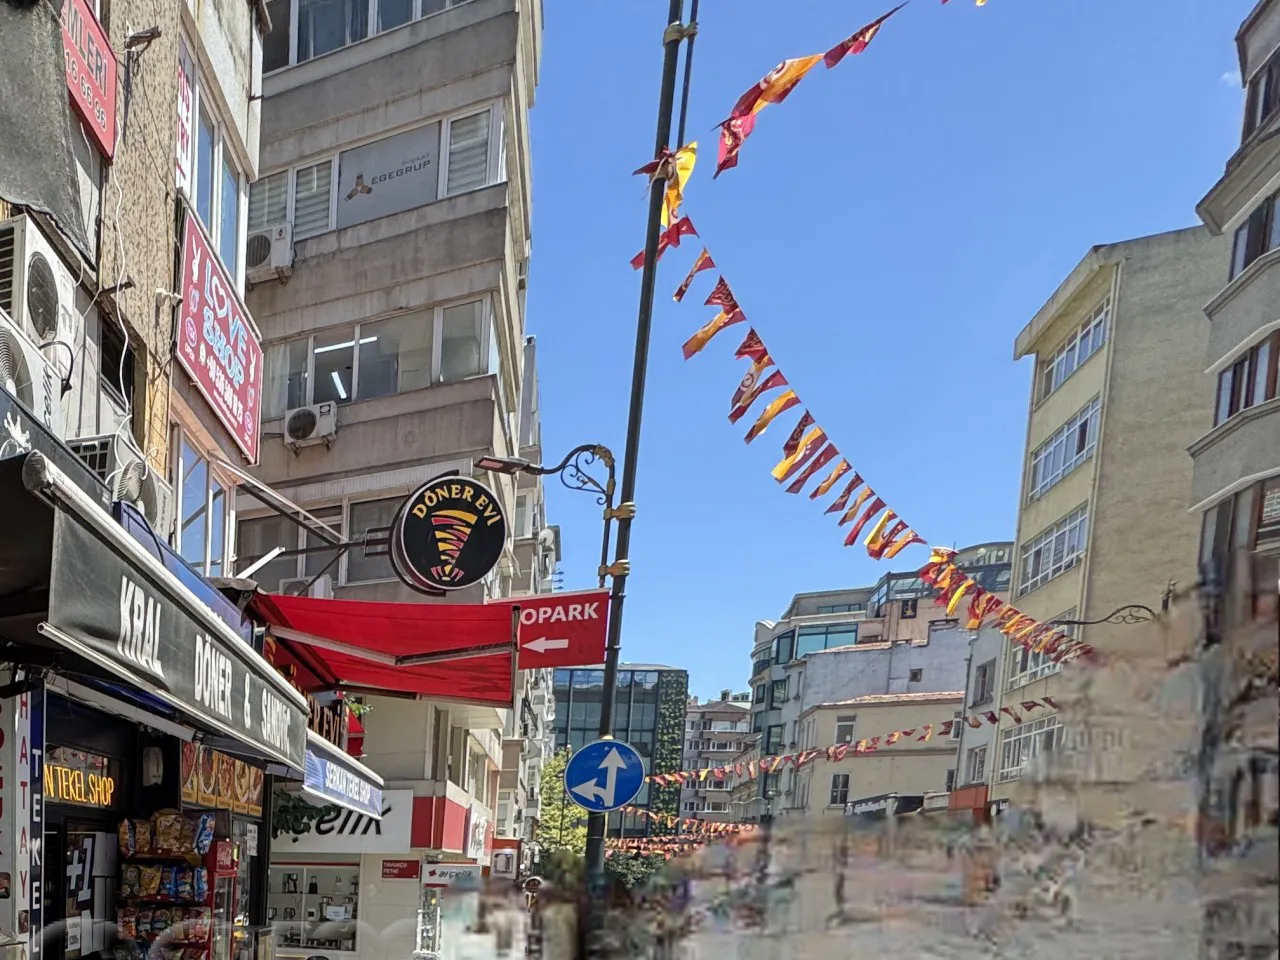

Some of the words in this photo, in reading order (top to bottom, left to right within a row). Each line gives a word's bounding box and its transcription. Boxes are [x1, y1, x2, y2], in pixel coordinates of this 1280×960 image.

[80, 75, 94, 109] 66
[94, 98, 108, 133] 96
[371, 159, 431, 186] EGEGRUP
[412, 484, 474, 519] DÖNER
[116, 574, 166, 680] KRAL
[194, 633, 232, 721] DÖNER
[243, 672, 252, 730] &
[54, 766, 87, 802] TEKEL
[88, 773, 114, 806] SHOP
[32, 748, 43, 953] TEKEL
